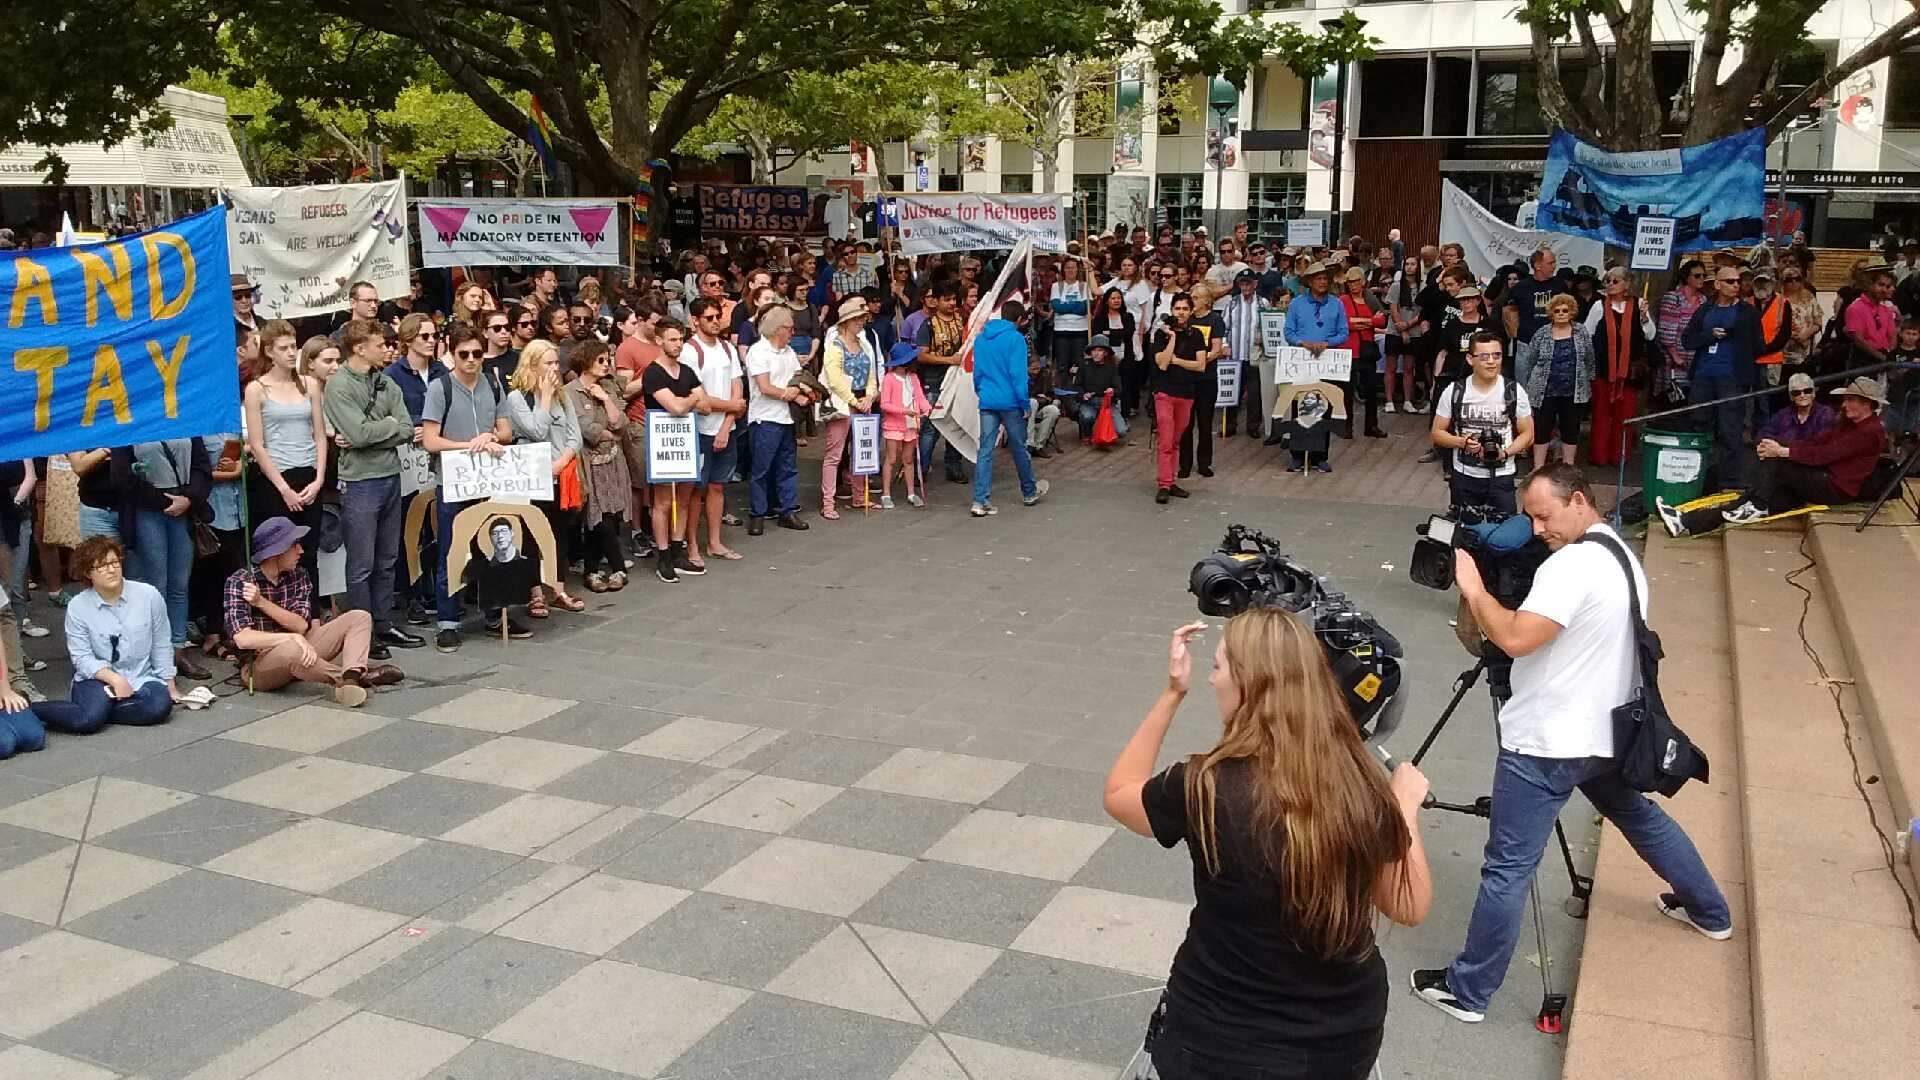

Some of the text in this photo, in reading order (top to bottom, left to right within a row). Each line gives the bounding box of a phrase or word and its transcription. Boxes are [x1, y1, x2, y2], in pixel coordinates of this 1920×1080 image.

[1813, 174, 1857, 183] SASHIMI
[1871, 175, 1904, 184] BENTO
[700, 186, 801, 214] Refugee
[301, 203, 348, 221] REFUGEES
[476, 214, 561, 224] NO PRIDE IN
[902, 202, 1057, 224] Justice for Refugees
[701, 207, 808, 234] Embassy
[437, 231, 605, 243] MANDATORY DETENTION
[1640, 225, 1671, 235] REFUGEE
[286, 231, 360, 252] ARE WELCOME
[952, 238, 985, 248] Refugee
[1644, 237, 1664, 245] LIVES
[1638, 247, 1666, 257] MATTER
[8, 231, 197, 328] AND
[300, 290, 350, 308] Violence
[14, 335, 191, 432] TAY
[1461, 403, 1490, 419] LIVE
[655, 423, 691, 433] REFUGEE
[661, 437, 685, 447] LIVES
[656, 451, 691, 461] MATTER
[456, 461, 531, 482] BACK
[455, 478, 545, 498] TURNBULL
